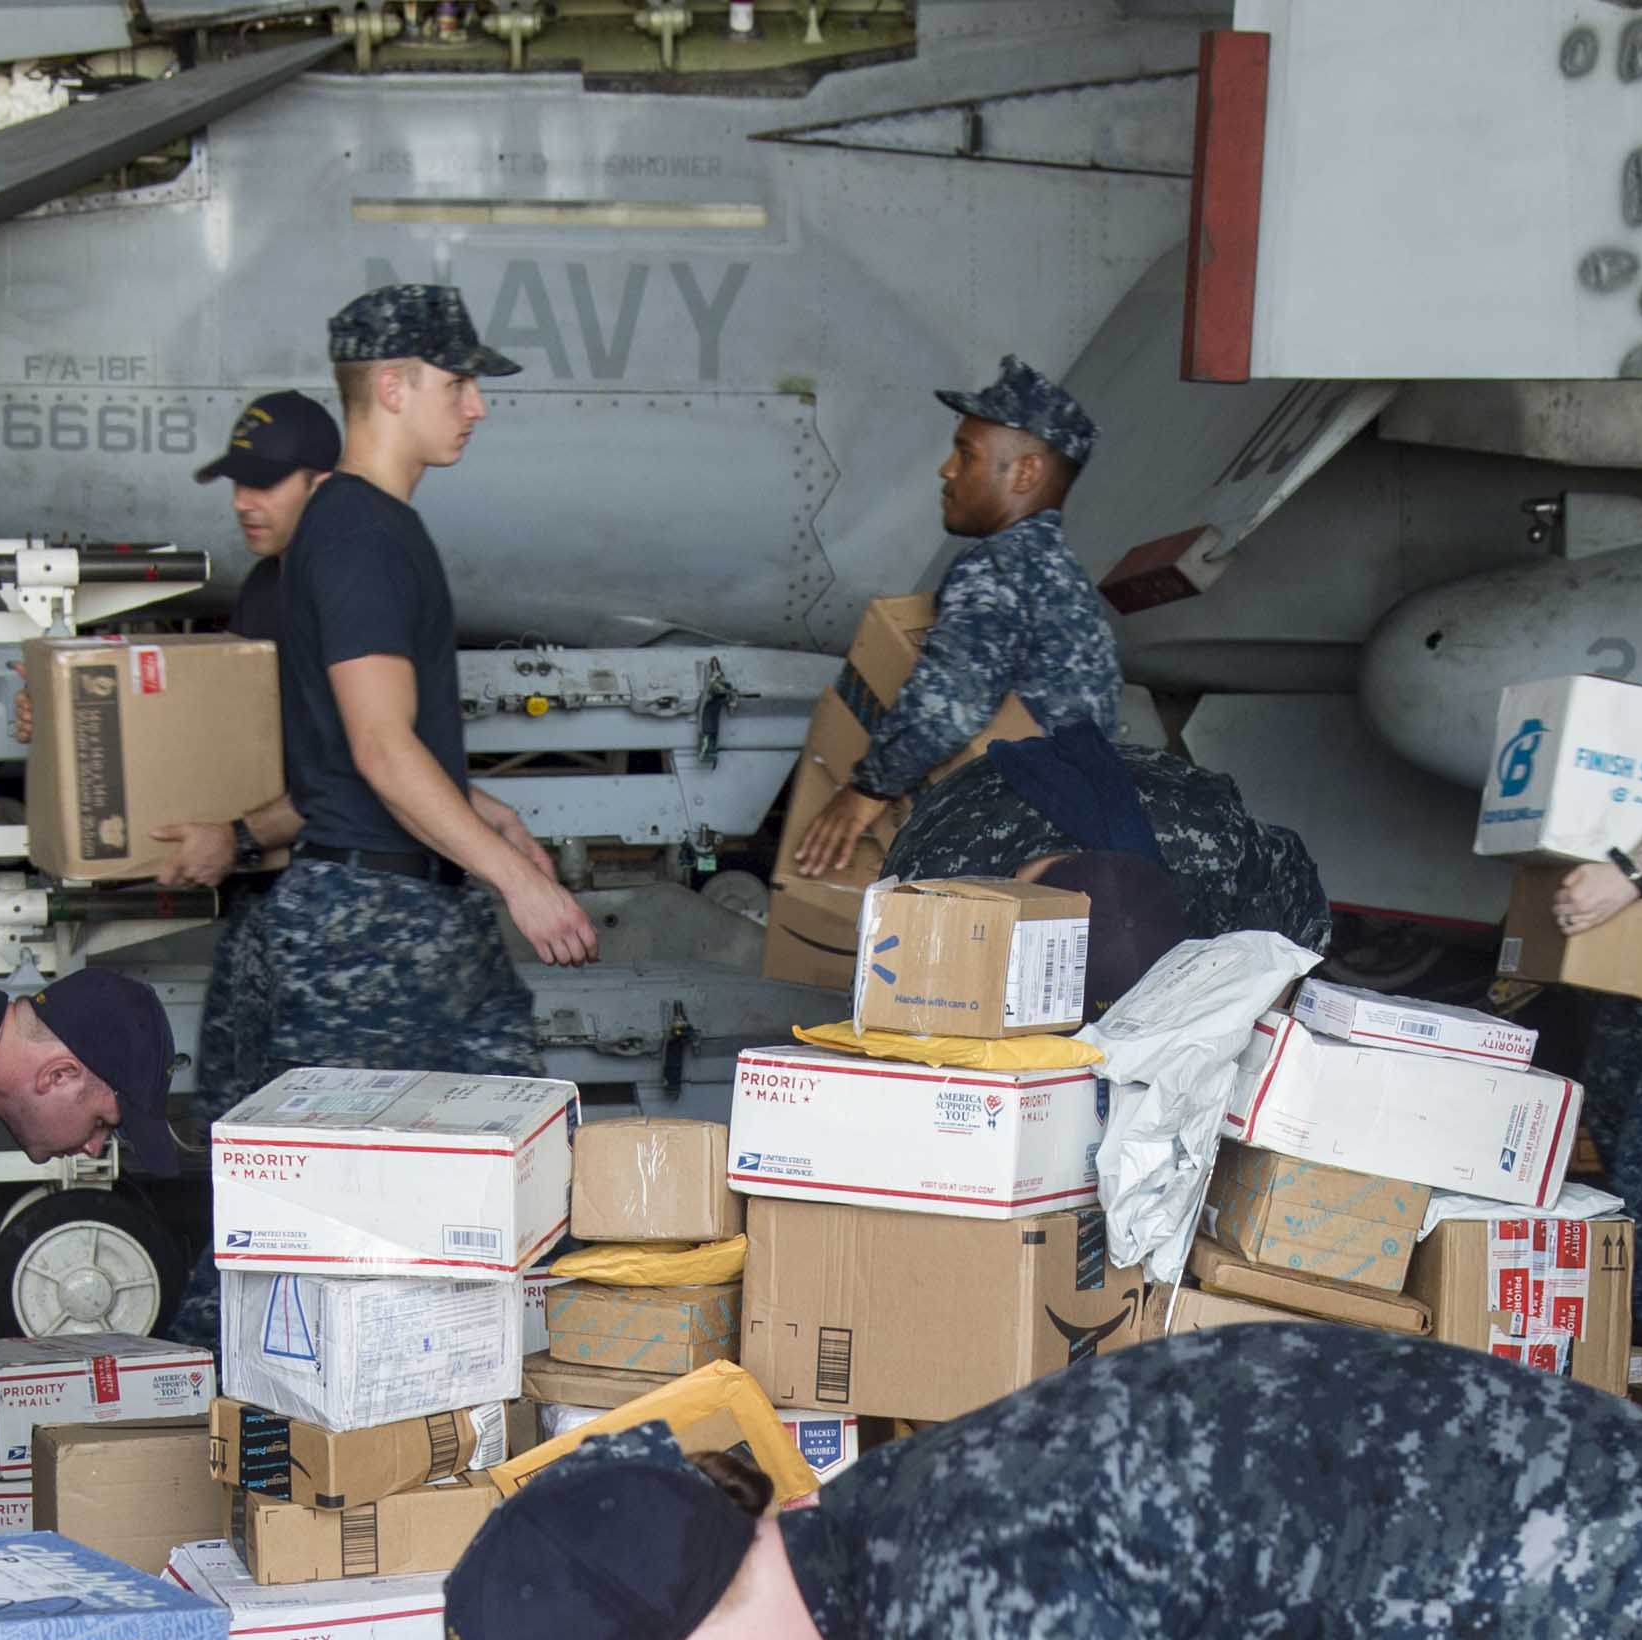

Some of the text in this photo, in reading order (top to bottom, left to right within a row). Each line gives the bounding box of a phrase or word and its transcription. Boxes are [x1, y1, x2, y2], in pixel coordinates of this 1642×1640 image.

[23, 355, 148, 383] F/A-18F
[1575, 747, 1634, 779] FINISH
[895, 994, 925, 1008] Handle
[927, 997, 948, 1009] with
[1477, 1037, 1532, 1057] PRIORITY
[740, 1071, 818, 1091] PRIORITY
[757, 1089, 799, 1104] MAIL
[937, 1092, 982, 1104] AMERICA
[935, 1102, 982, 1113] SUPPORTS
[944, 1111, 970, 1121] YOU
[222, 1151, 308, 1169] PRIORITY
[244, 1168, 288, 1181] MAIL
[3, 1383, 66, 1398] PRIORITY
[161, 1390, 181, 1398] YOU
[18, 1396, 52, 1408] MAIL
[804, 1429, 837, 1438] TRACKED
[804, 1446, 837, 1457] INSURED
